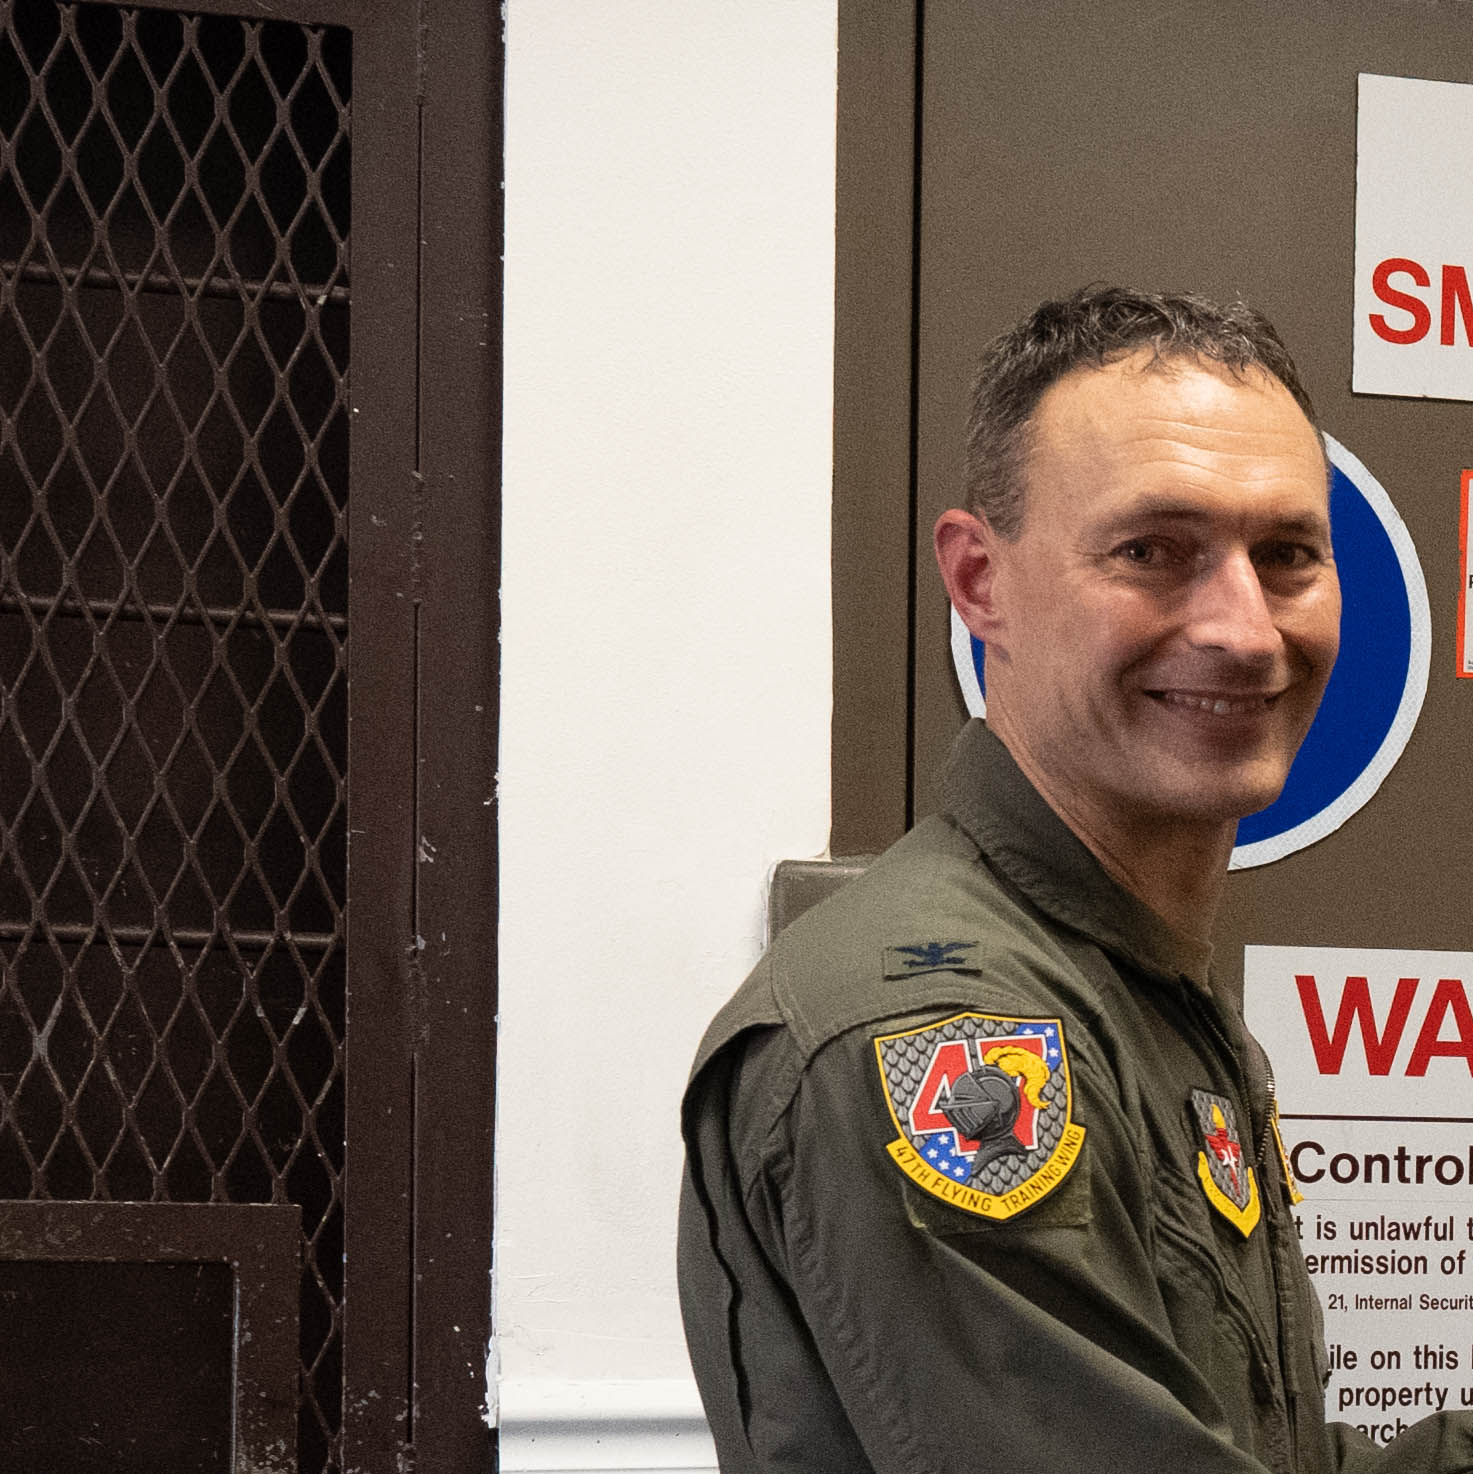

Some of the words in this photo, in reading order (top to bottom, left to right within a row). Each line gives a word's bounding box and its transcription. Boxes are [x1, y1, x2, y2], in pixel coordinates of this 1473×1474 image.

[909, 1033, 1048, 1156] 47
[895, 1146, 929, 1181] 47TH
[931, 1175, 993, 1213] FLYING
[1000, 1160, 1063, 1213] TRAINING
[1058, 1128, 1081, 1170] WING
[1316, 1214, 1337, 1241] is
[1349, 1214, 1454, 1242] unlawful
[1304, 1248, 1428, 1275] ermission
[1440, 1249, 1467, 1276] of
[1327, 1293, 1348, 1313] 21,
[1355, 1293, 1413, 1311] Internal
[1329, 1343, 1358, 1371] ile
[1370, 1350, 1401, 1371] on
[1412, 1343, 1459, 1371] this
[1338, 1381, 1449, 1413] property
